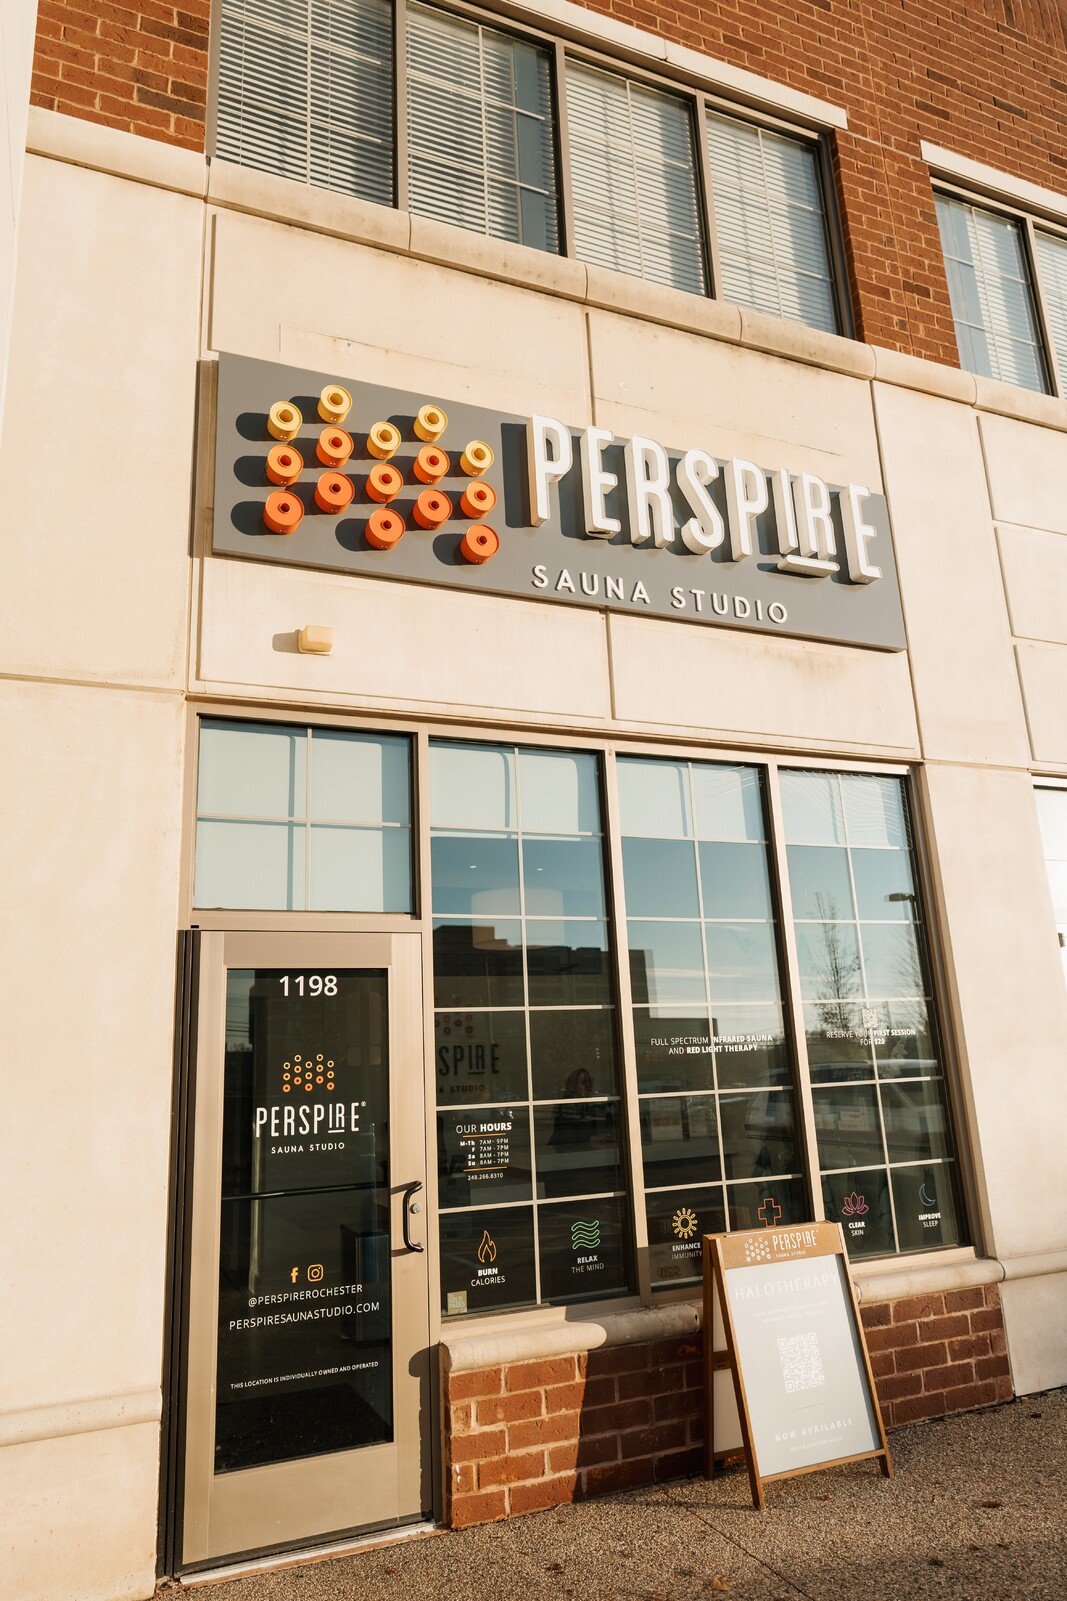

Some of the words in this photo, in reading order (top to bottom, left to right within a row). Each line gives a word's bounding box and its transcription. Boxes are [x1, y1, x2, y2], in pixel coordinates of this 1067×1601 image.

[526, 413, 883, 585] PERSPIRE
[531, 564, 650, 604] SAUNA
[670, 586, 788, 624] STUDIO
[279, 975, 338, 996] 1198
[650, 1038, 668, 1046] FULL
[670, 1037, 709, 1045] SPECTRUM
[710, 1036, 745, 1044] INFRARED
[746, 1034, 773, 1042] SAUNA
[826, 1030, 853, 1039] RESERVE
[668, 1047, 684, 1055] AND
[686, 1046, 700, 1054] RED
[702, 1045, 723, 1053] LIGHT
[724, 1044, 758, 1052] THERAPY
[450, 1084, 485, 1093] STUDIO
[456, 1124, 477, 1134] OUR
[480, 1122, 512, 1132] HOURS
[271, 1145, 304, 1154] SAUNA
[309, 1142, 345, 1152] STUDIO
[918, 1212, 941, 1220] IMPROVE
[848, 1221, 865, 1229] CLEAR
[923, 1220, 938, 1228] SLEEP
[672, 1242, 701, 1251] ENHANCE
[577, 1255, 598, 1264] RELAX
[671, 1250, 702, 1260] IMMUNITY
[477, 1267, 498, 1277] BURN
[571, 1266, 584, 1274] THE
[586, 1262, 604, 1271] MIND
[470, 1275, 506, 1287] CALORIES
[734, 1273, 838, 1301] HALOTHERAPY
[248, 1284, 363, 1308] @PERSPIREROCHESTER
[229, 1302, 380, 1330] PERSPIRESAUNASTUDIO.COM
[244, 1378, 273, 1387] LOCATION
[280, 1371, 318, 1382] INDIVIDUALLY
[318, 1367, 339, 1376] OWNED
[351, 1361, 379, 1370] OPERATED
[775, 1430, 796, 1442] NOW
[801, 1417, 853, 1436] AVAILABLE
